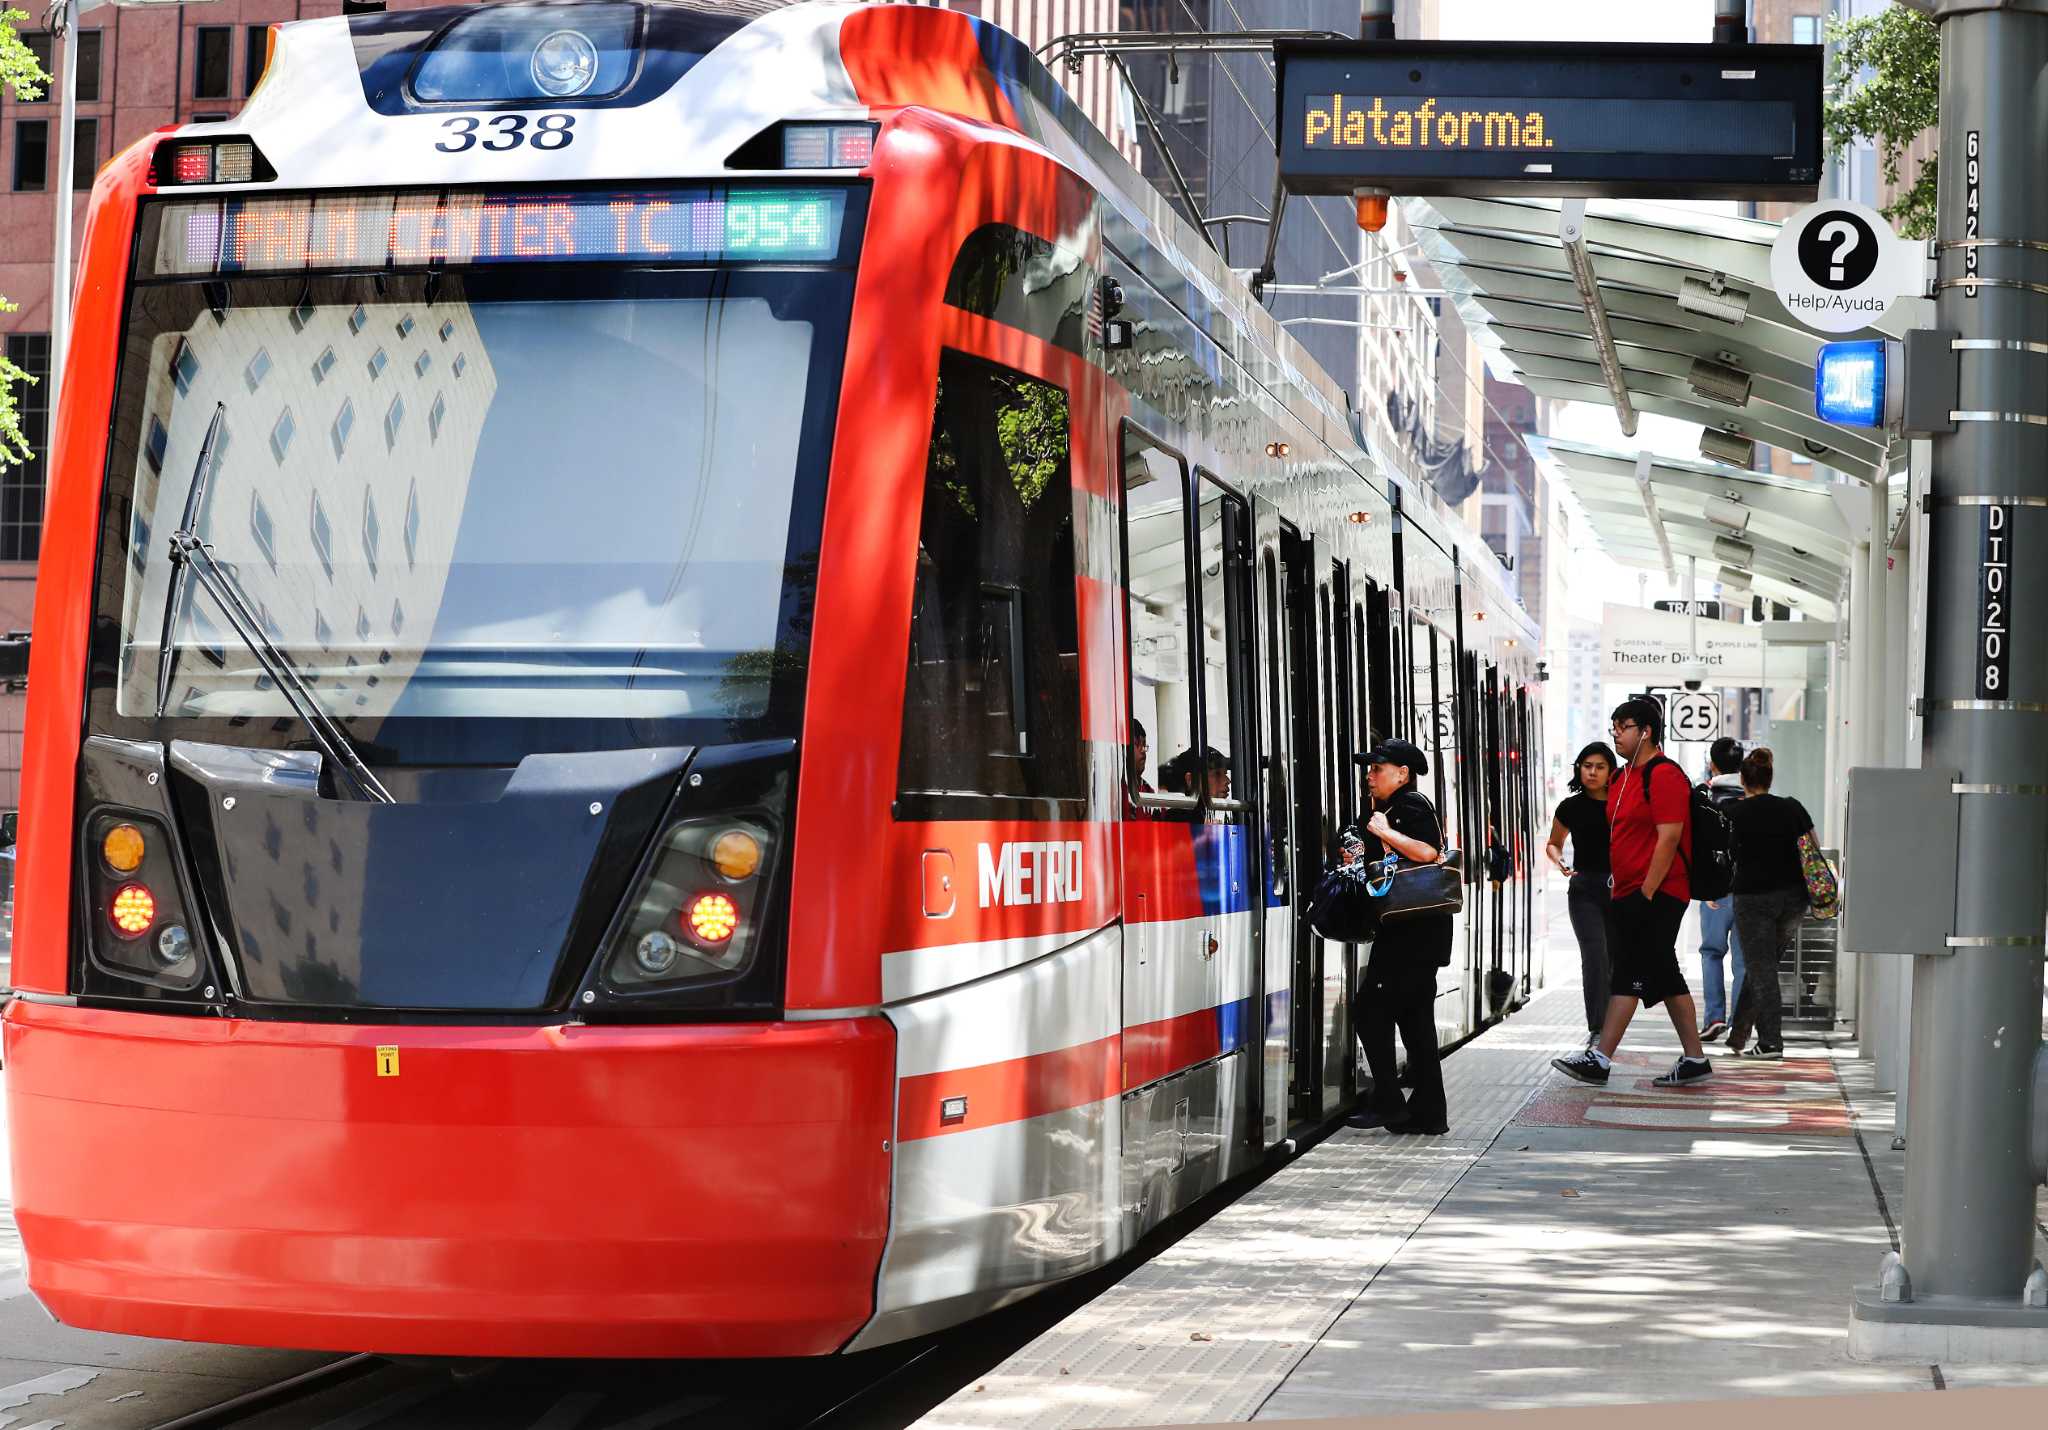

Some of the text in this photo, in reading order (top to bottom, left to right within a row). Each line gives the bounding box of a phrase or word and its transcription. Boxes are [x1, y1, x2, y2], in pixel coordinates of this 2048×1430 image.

[434, 113, 577, 153] 338
[1305, 93, 1553, 147] plataforma.
[388, 202, 576, 258] CENTER
[607, 201, 671, 254] TC
[726, 202, 821, 249] 954
[1788, 293, 1885, 314] Help/Ayuda
[1611, 650, 1723, 665] Theater Dirict
[1680, 704, 1712, 730] 25
[977, 840, 1082, 909] METRO
